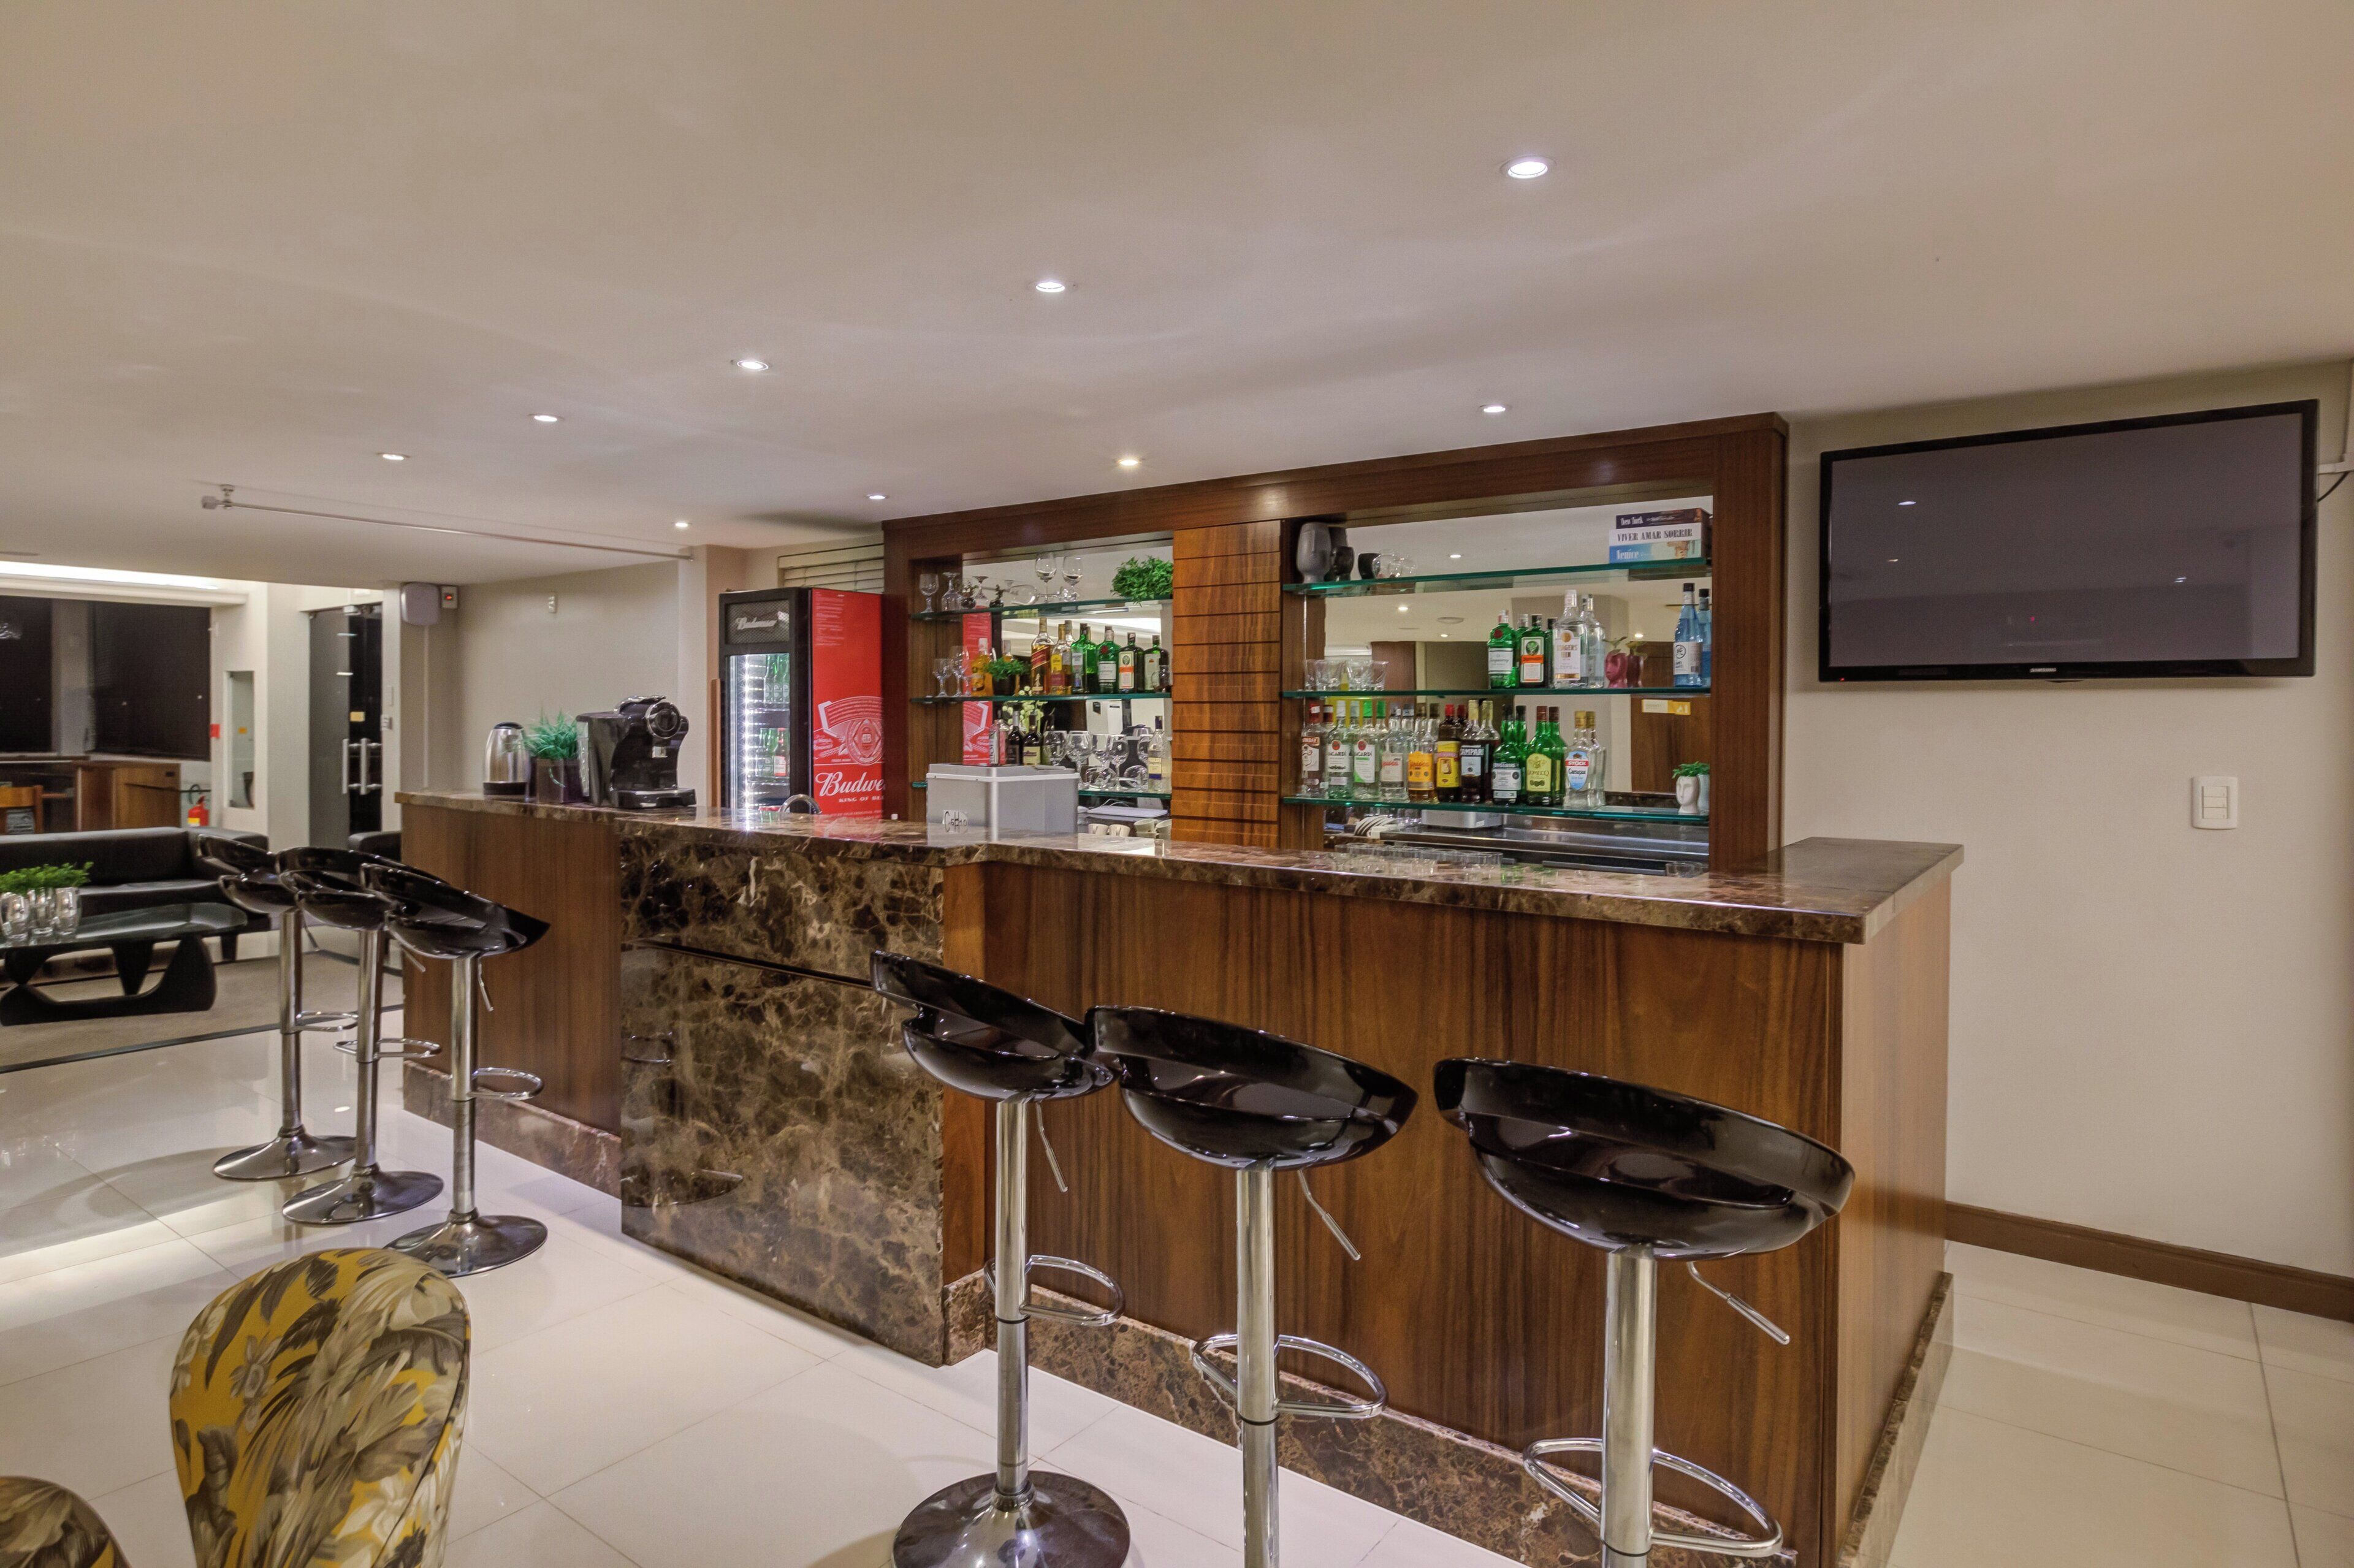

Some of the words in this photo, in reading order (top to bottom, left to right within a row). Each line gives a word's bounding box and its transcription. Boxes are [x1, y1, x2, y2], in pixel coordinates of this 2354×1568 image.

[1617, 533, 1638, 542] VIVER
[1641, 531, 1661, 540] AMAR
[1664, 528, 1693, 539] SORRIR
[1617, 549, 1639, 560] Venice
[815, 771, 883, 796] Budwe
